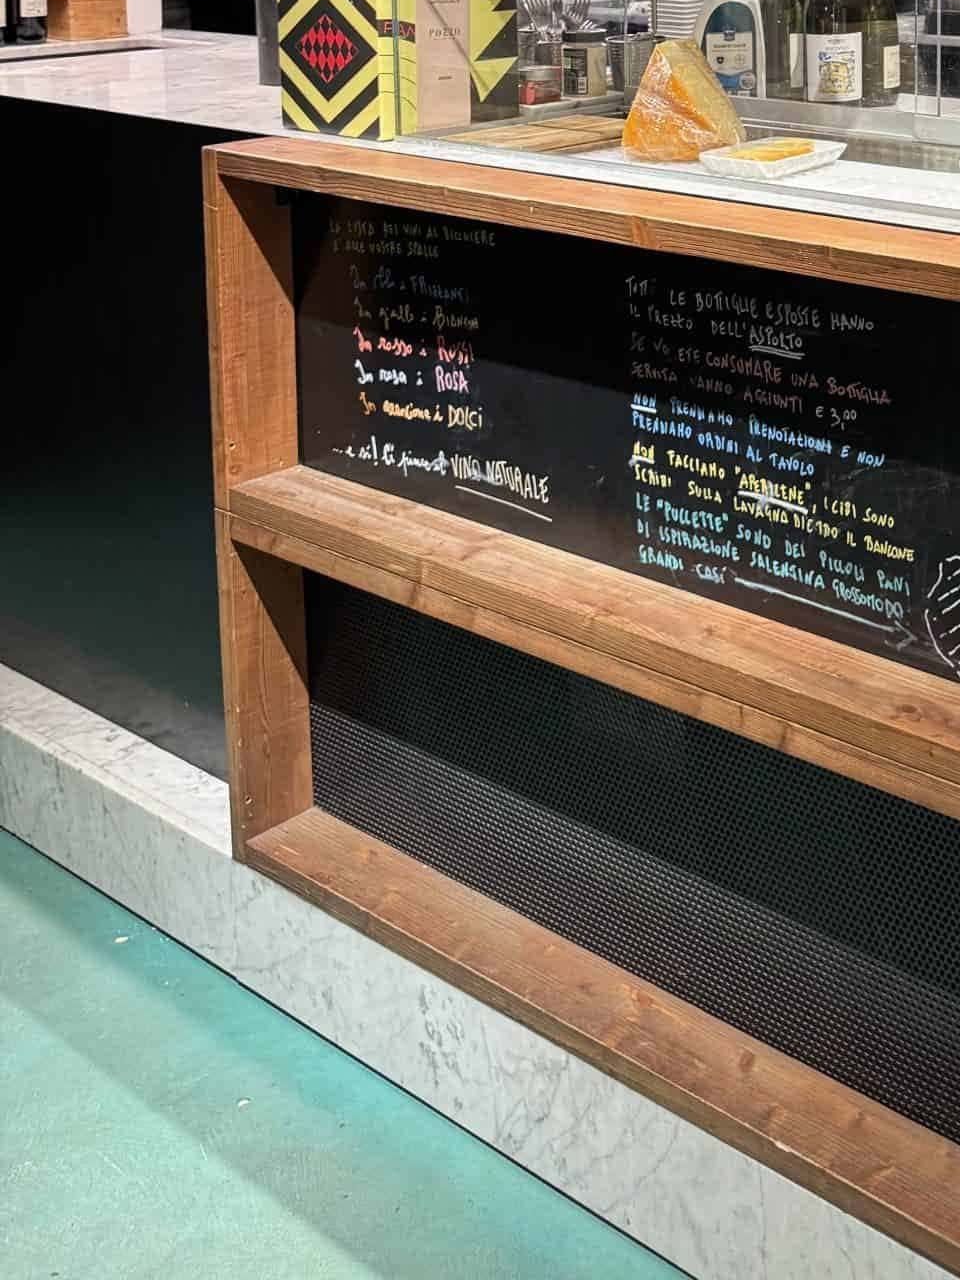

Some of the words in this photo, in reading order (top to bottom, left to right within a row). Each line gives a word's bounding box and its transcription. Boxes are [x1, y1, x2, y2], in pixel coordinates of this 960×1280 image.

[647, 305, 694, 331] PREZZO
[669, 289, 687, 307] LE
[695, 291, 759, 320] BOTTIGLIE
[765, 303, 821, 328] ESPOSTE
[830, 312, 875, 332] HANNO
[705, 351, 783, 386] CONSUMARE
[791, 372, 819, 390] UNA
[825, 376, 892, 406] BOTTIGLIA
[743, 389, 804, 415] AGGIUNTI
[632, 392, 657, 408] NON
[748, 414, 833, 455] PRENOTAZIONI
[840, 445, 851, 459] E
[857, 452, 886, 468] NON
[698, 431, 740, 455] ORDINI
[746, 445, 763, 463] AL
[769, 452, 815, 477] TAVOLO
[450, 454, 481, 482] VINO
[485, 460, 550, 504] NATURALE
[632, 441, 655, 459] NON
[862, 507, 896, 529] SONO
[635, 491, 651, 513] LE
[735, 523, 772, 550] SONO
[784, 538, 805, 559] DEI
[819, 549, 865, 583] PICCOLI
[876, 568, 910, 597] PANI
[687, 482, 722, 505] SULLA
[734, 496, 789, 525] LAVAGNA
[792, 512, 839, 539] DIETRO
[845, 531, 857, 548] IL
[863, 535, 915, 562] BANCONE
[636, 518, 650, 540] DI
[658, 524, 741, 562] ISPIRAZIONE
[749, 551, 825, 591] SALENTINA
[832, 578, 904, 619] GROSSOMODO
[638, 544, 685, 571] GRANDI
